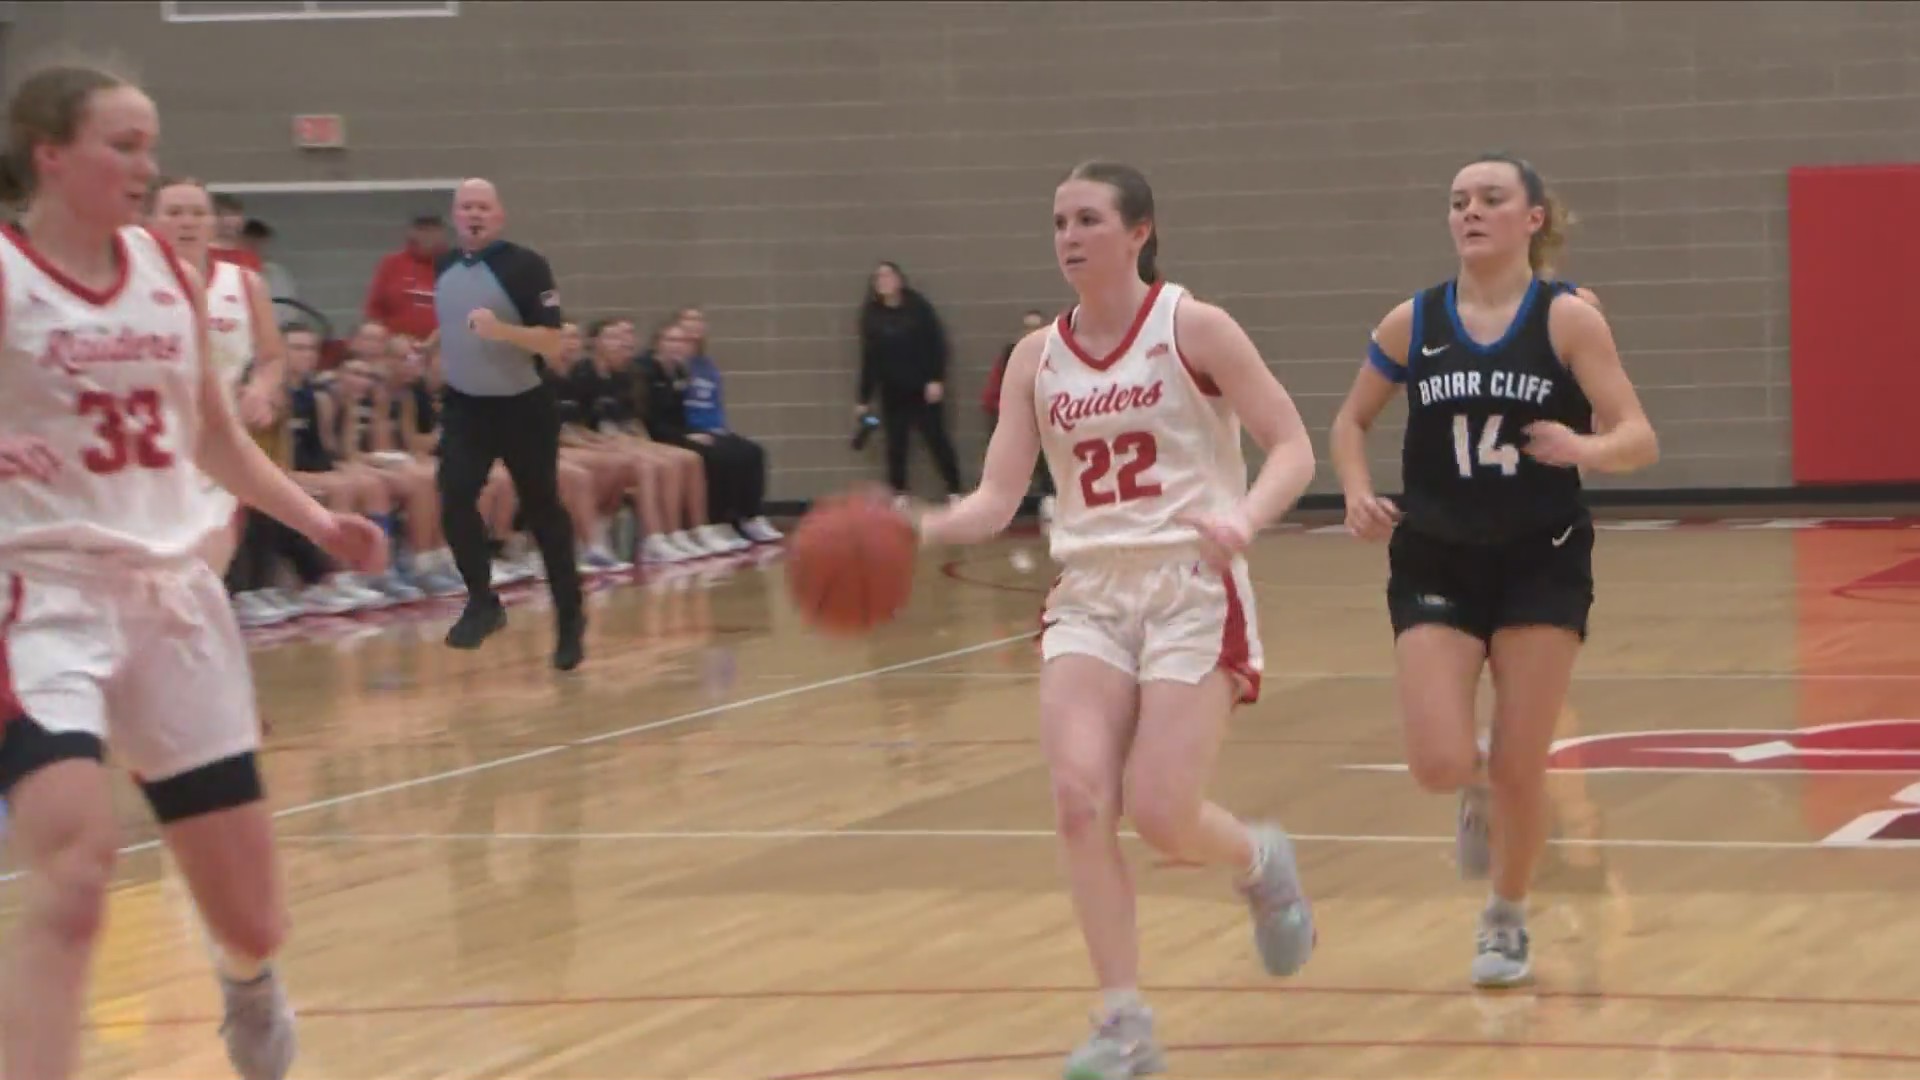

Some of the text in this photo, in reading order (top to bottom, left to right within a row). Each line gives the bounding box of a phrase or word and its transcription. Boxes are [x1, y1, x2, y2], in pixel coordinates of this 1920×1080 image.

[1050, 380, 1163, 433] Raiders
[1419, 371, 1552, 406] BRIAR CLIFF
[79, 390, 176, 475] 32
[1453, 413, 1520, 478] 14
[1073, 431, 1163, 508] 22
